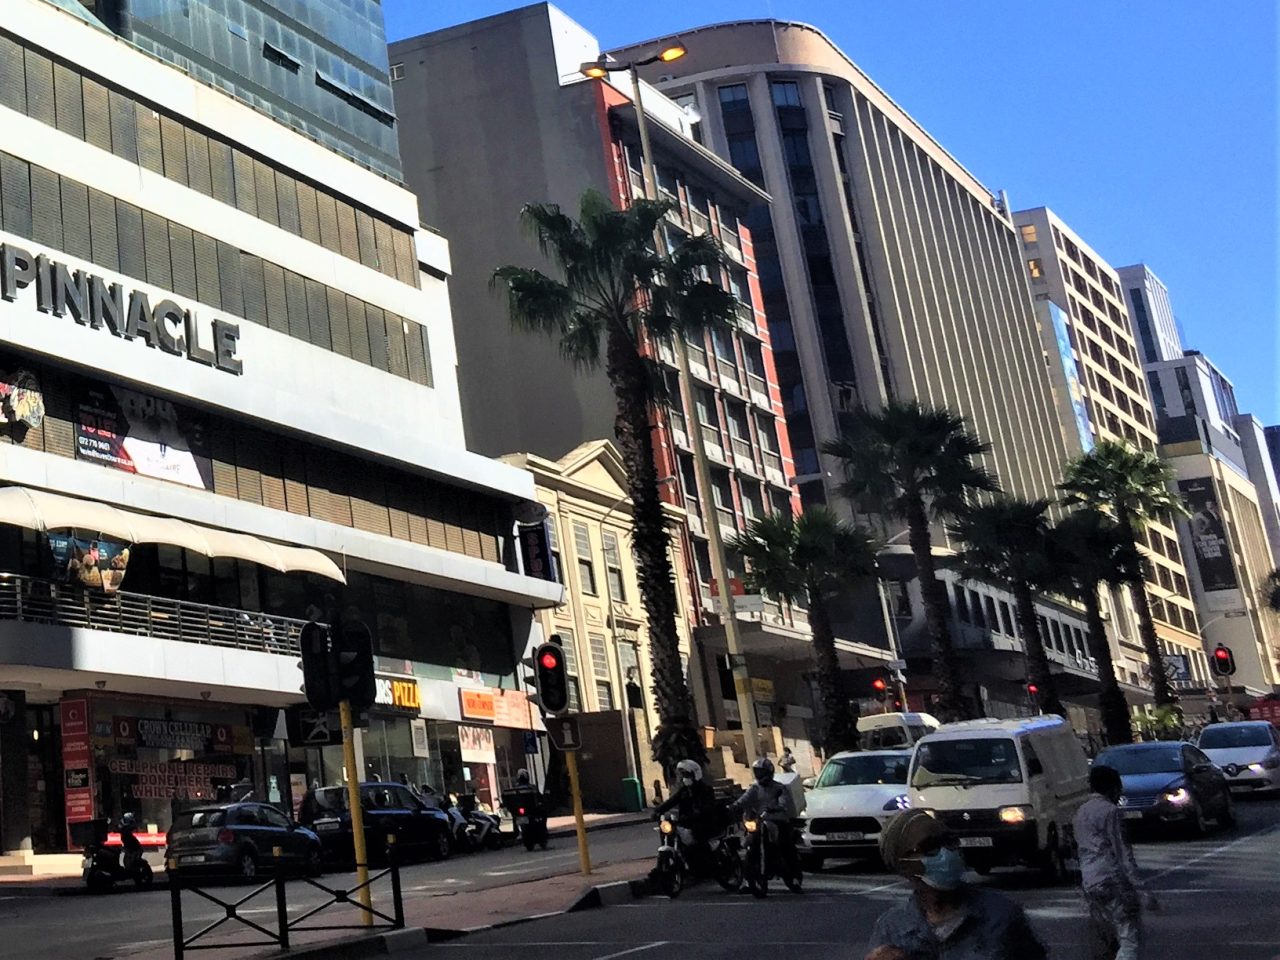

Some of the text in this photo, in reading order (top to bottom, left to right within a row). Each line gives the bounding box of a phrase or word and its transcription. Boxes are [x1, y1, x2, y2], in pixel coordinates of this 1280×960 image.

[393, 681, 423, 708] PIZZA
[109, 759, 237, 779] CELLPHONE REPAIRS
[140, 775, 210, 788] DONE HERE
[131, 785, 171, 799] WHILE
